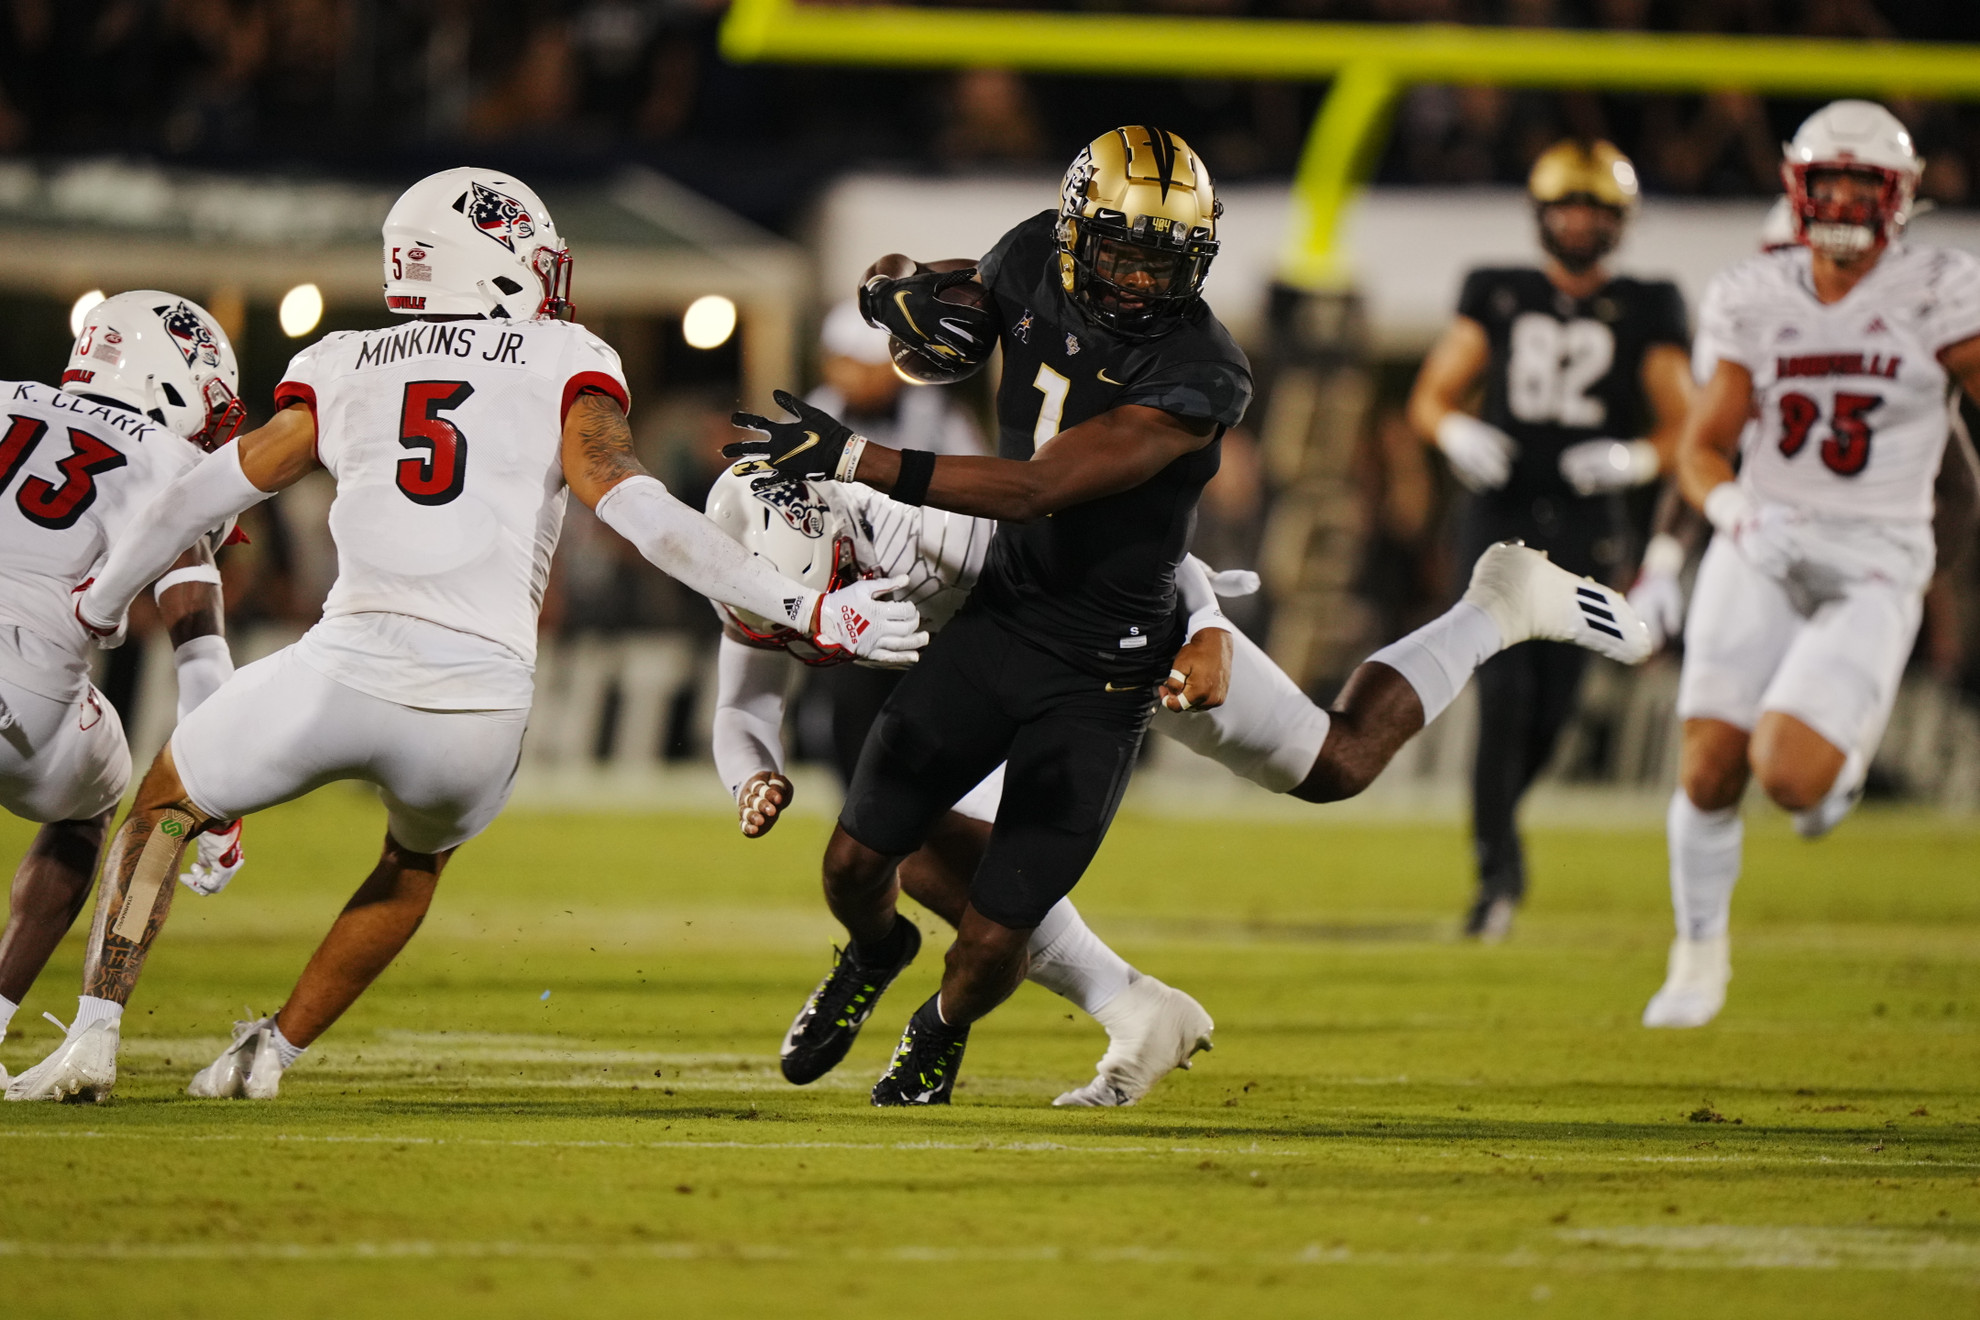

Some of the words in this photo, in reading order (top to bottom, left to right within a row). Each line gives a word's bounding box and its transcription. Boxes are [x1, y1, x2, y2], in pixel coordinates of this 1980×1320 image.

[392, 247, 402, 280] 5
[75, 326, 98, 356] 13
[355, 325, 476, 370] MINKINS
[482, 332, 526, 365] JR.
[1506, 312, 1615, 427] 82
[13, 384, 38, 403] K.
[51, 393, 157, 443] CLARK
[1032, 362, 1071, 452] 1
[396, 380, 475, 506] 5
[1779, 390, 1884, 477] 95
[0, 413, 128, 531] 13
[790, 596, 804, 621] adidas
[841, 605, 858, 645] adidas
[1130, 626, 1140, 636] S
